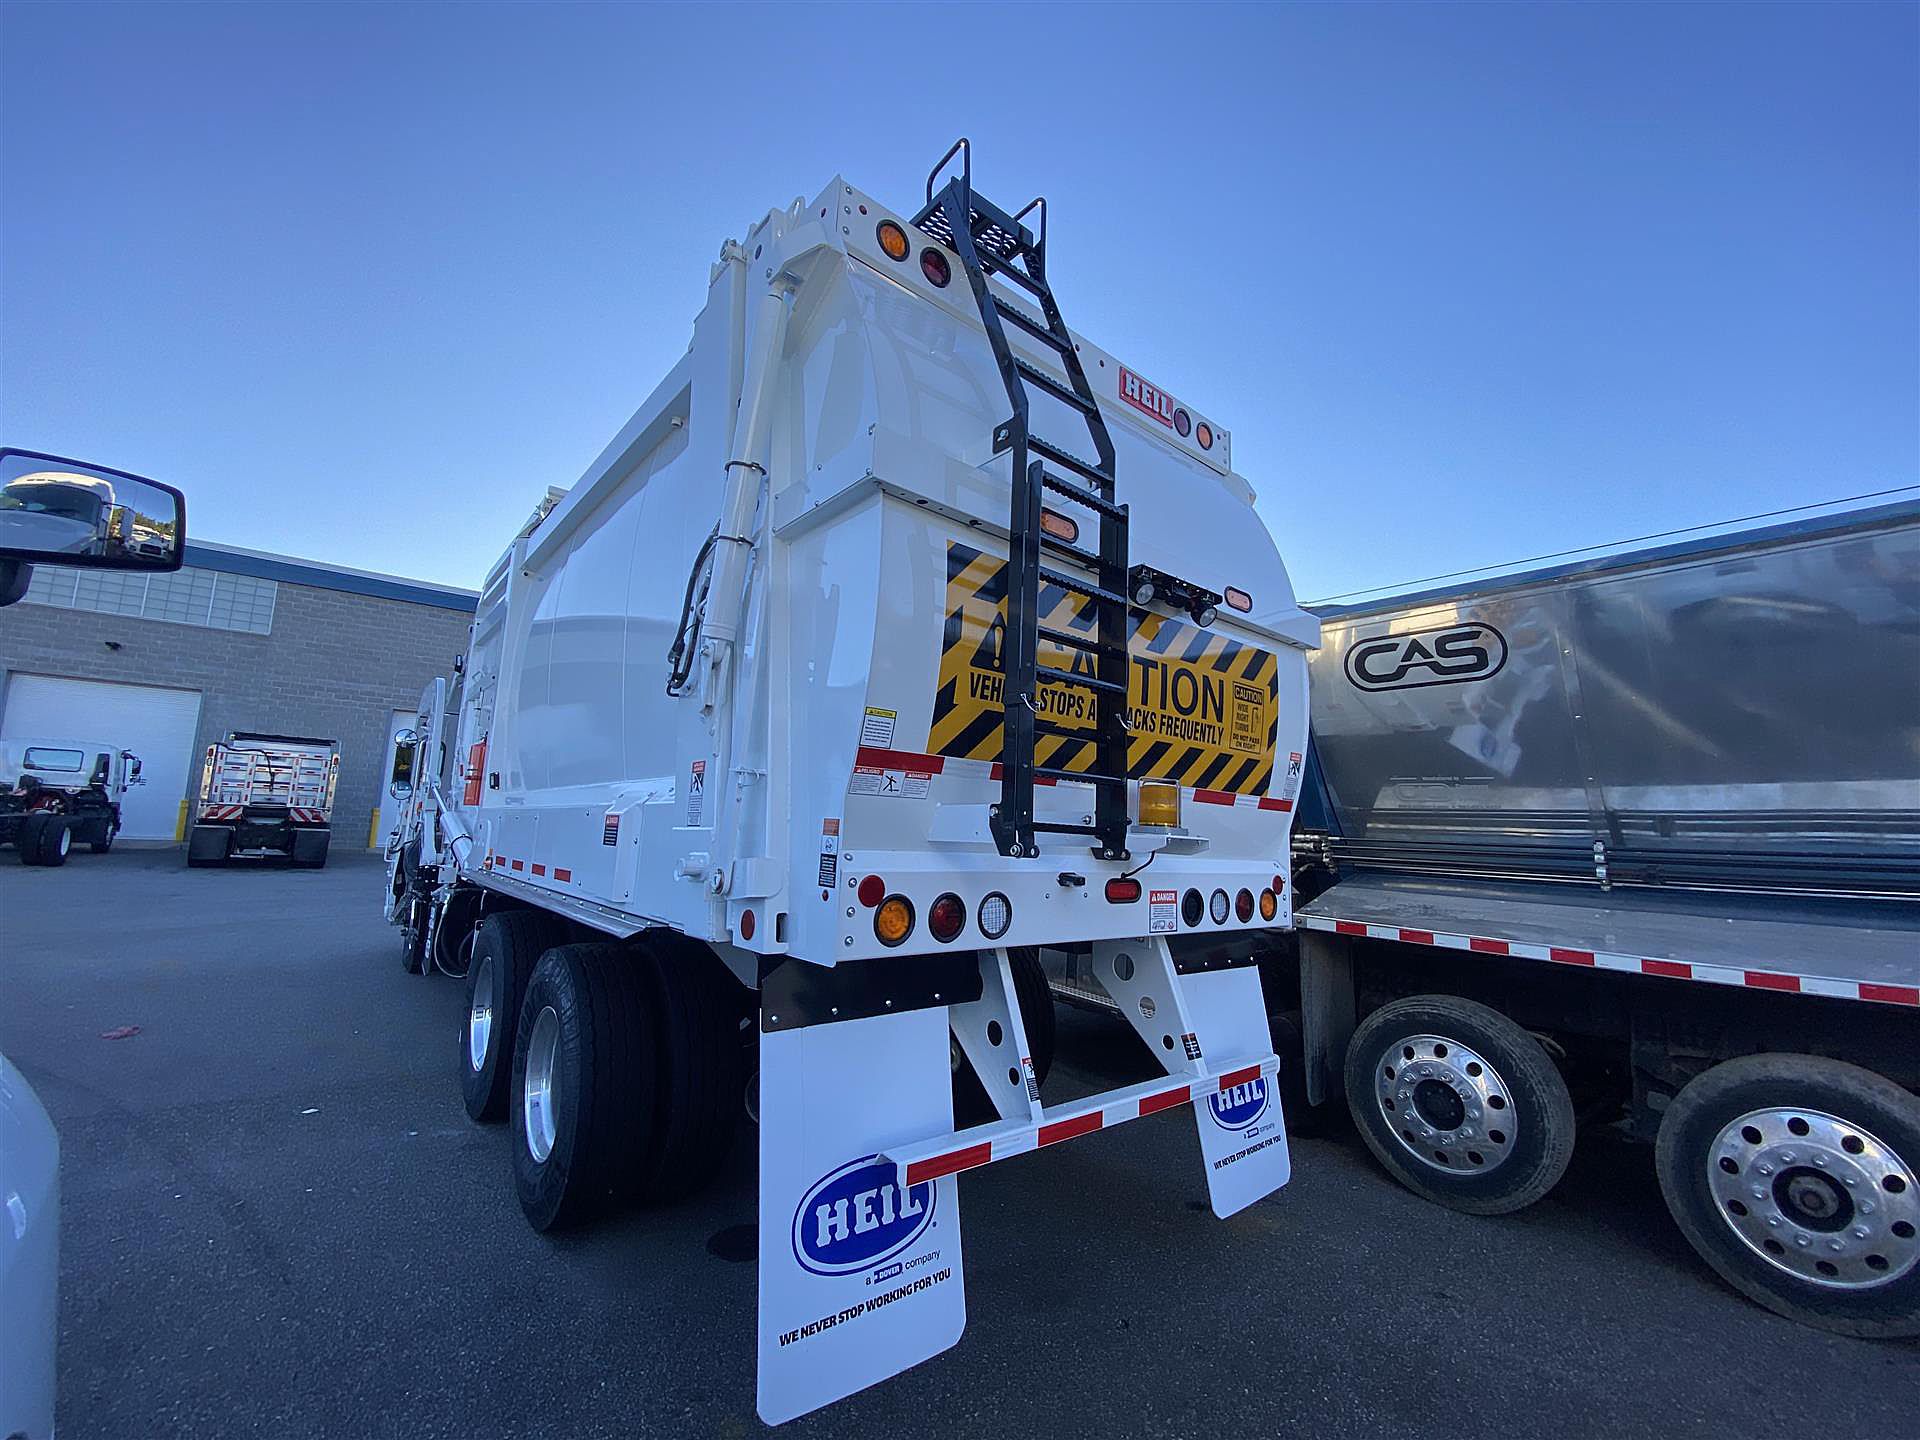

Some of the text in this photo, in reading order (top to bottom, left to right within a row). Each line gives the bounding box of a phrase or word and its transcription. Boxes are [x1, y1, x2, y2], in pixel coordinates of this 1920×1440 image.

[1125, 371, 1172, 420] HEIL
[1355, 630, 1489, 684] CAS
[1040, 687, 1084, 719] STOPS
[1127, 706, 1157, 733] ACKS
[1159, 713, 1224, 746] FREQUENTLY
[1235, 687, 1262, 705] CAUTION
[1217, 1079, 1263, 1112] HEIL
[1222, 1154, 1236, 1167] NEVER
[1236, 1149, 1246, 1161] STOP
[1246, 1141, 1265, 1156] WORKING
[1265, 1137, 1273, 1147] FOR
[1273, 1134, 1281, 1144] YOU
[815, 1183, 923, 1248] HEIL
[865, 1250, 941, 1286] a DOVER company
[779, 1267, 951, 1347] WE NEVER STOP WORKING FOR YOU
